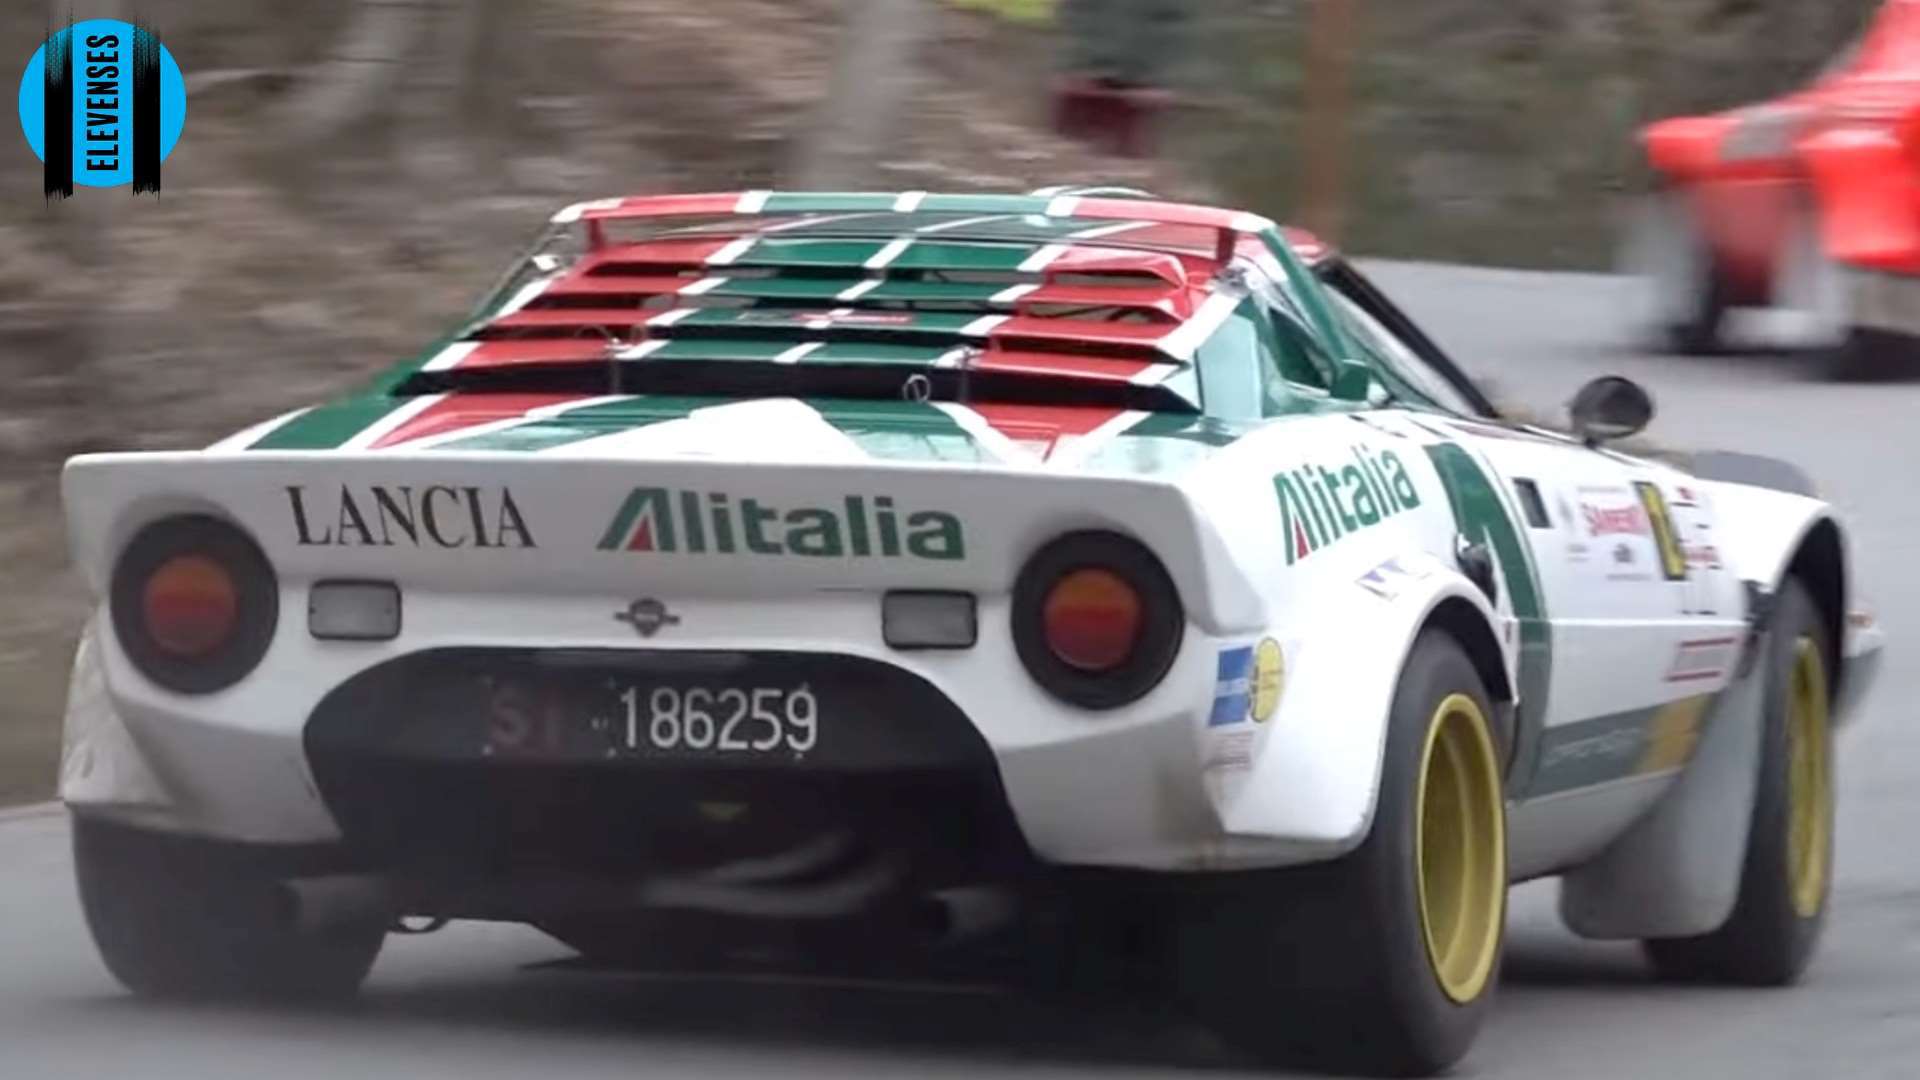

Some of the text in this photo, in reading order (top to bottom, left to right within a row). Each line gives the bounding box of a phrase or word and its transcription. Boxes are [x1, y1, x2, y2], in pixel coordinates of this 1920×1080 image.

[285, 483, 538, 548] LANCIA
[597, 486, 965, 560] Alitalia
[1273, 442, 1421, 566] Alitalia
[620, 687, 817, 751] 186259
